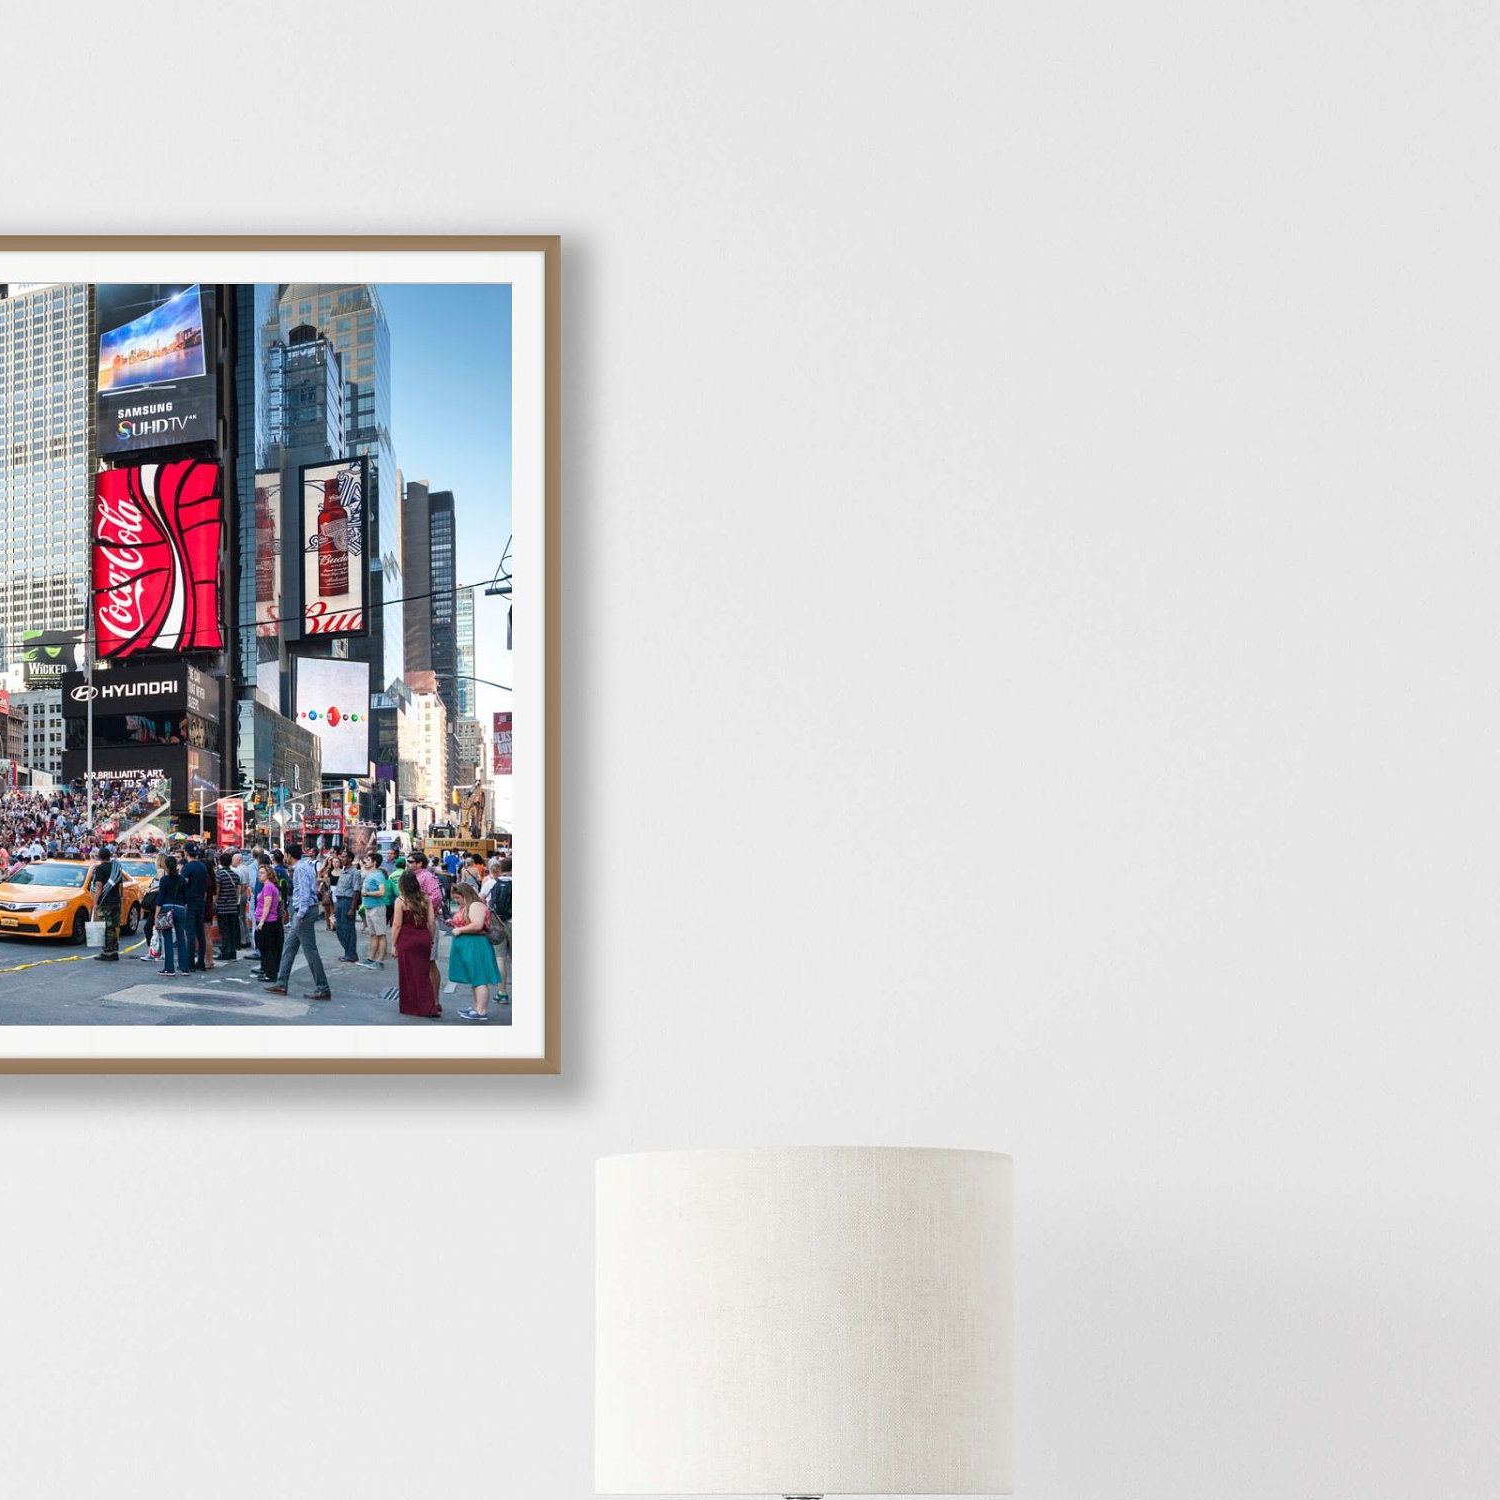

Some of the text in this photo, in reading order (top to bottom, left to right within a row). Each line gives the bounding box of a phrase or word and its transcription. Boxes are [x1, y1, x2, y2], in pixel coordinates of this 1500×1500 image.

[117, 402, 173, 419] SAMSUNG
[98, 495, 143, 639] Coca-Cola
[102, 680, 178, 698] HYUNDAI
[223, 801, 238, 831] tkts
